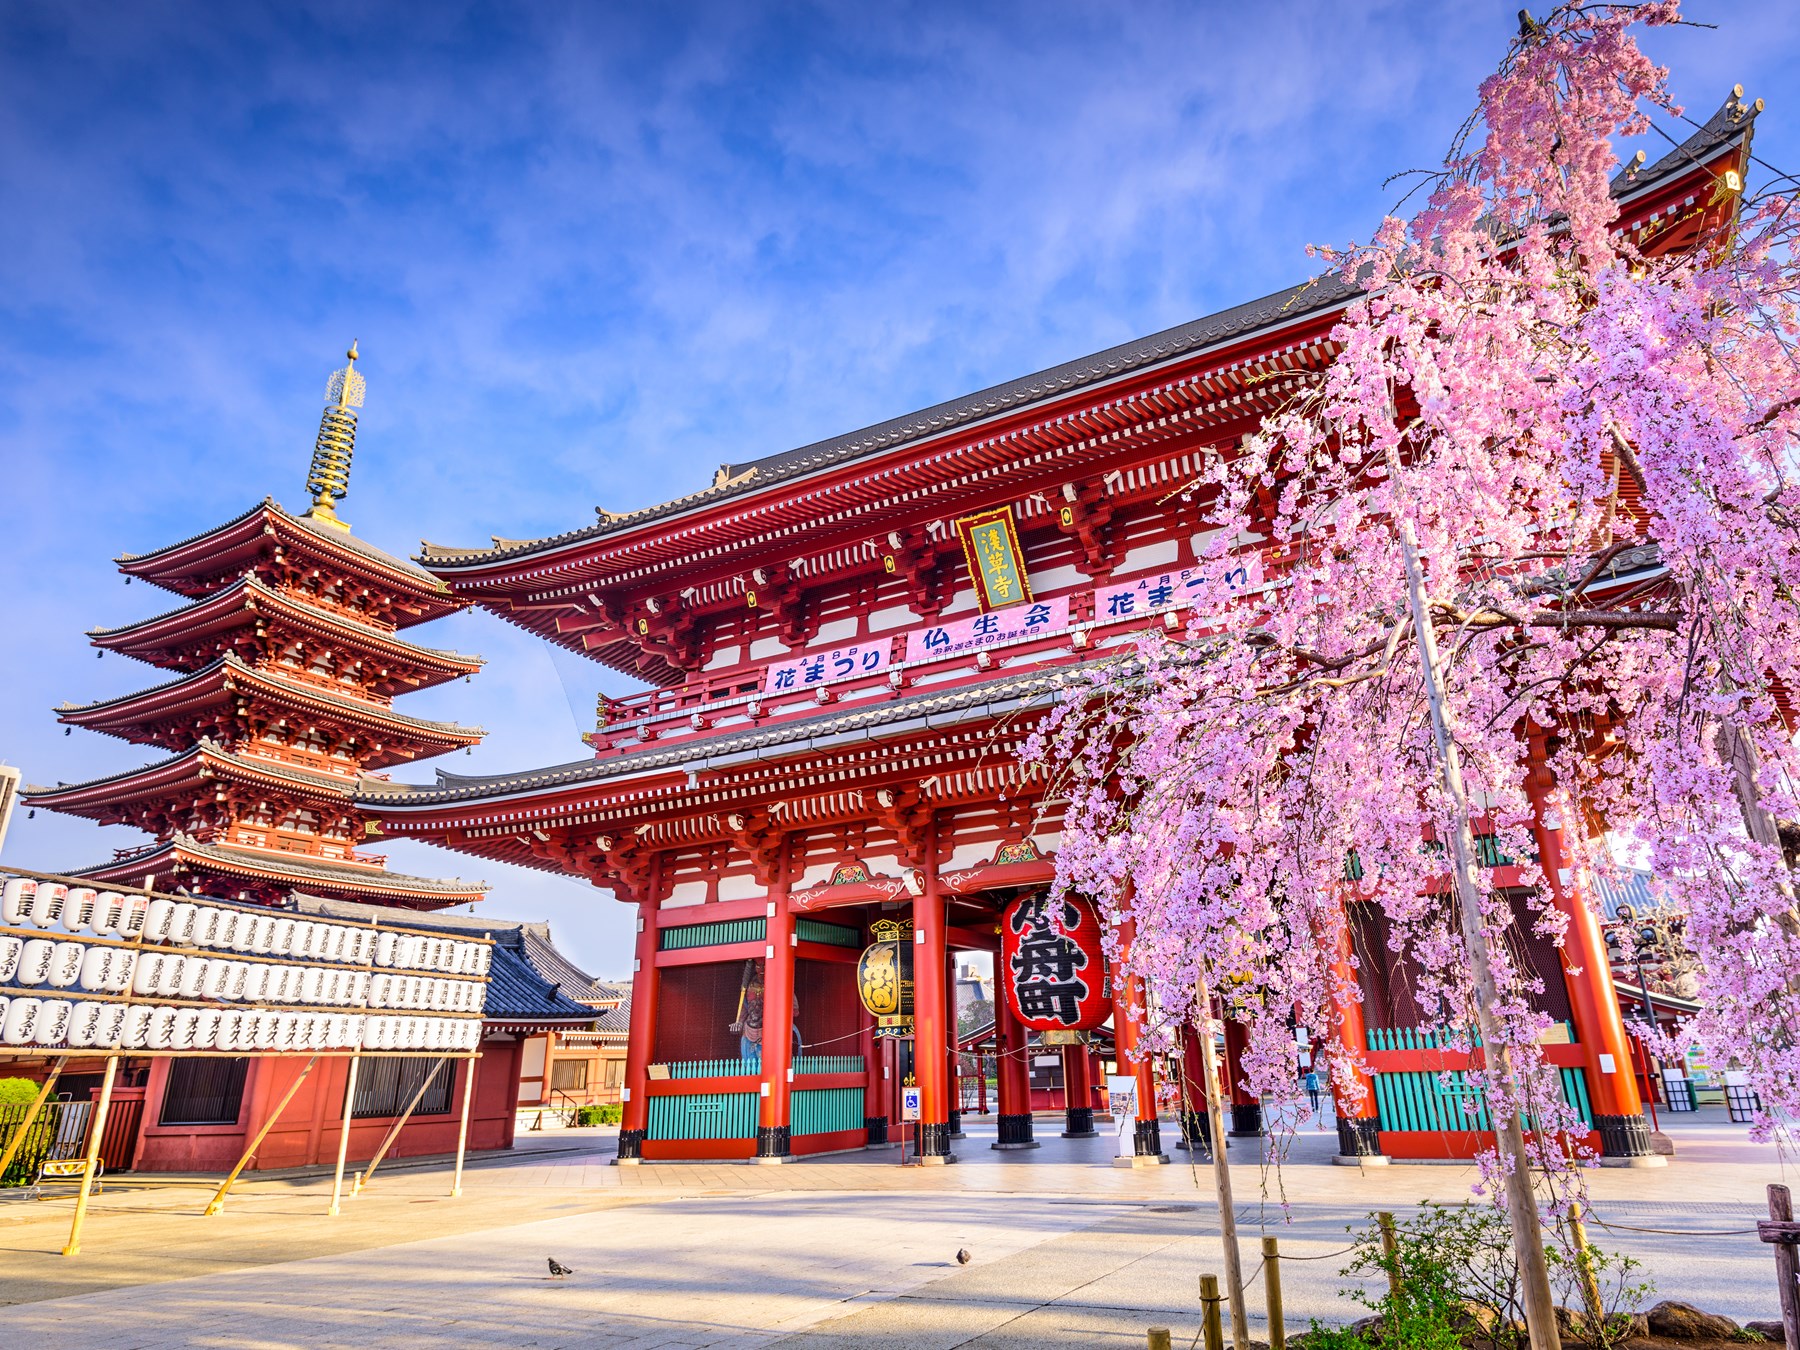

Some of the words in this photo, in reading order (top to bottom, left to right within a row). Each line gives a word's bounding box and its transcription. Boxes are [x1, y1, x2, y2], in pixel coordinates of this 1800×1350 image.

[923, 604, 1052, 650] 仏生会
[775, 650, 880, 689] 花まつり
[799, 647, 858, 667] 4月8日
